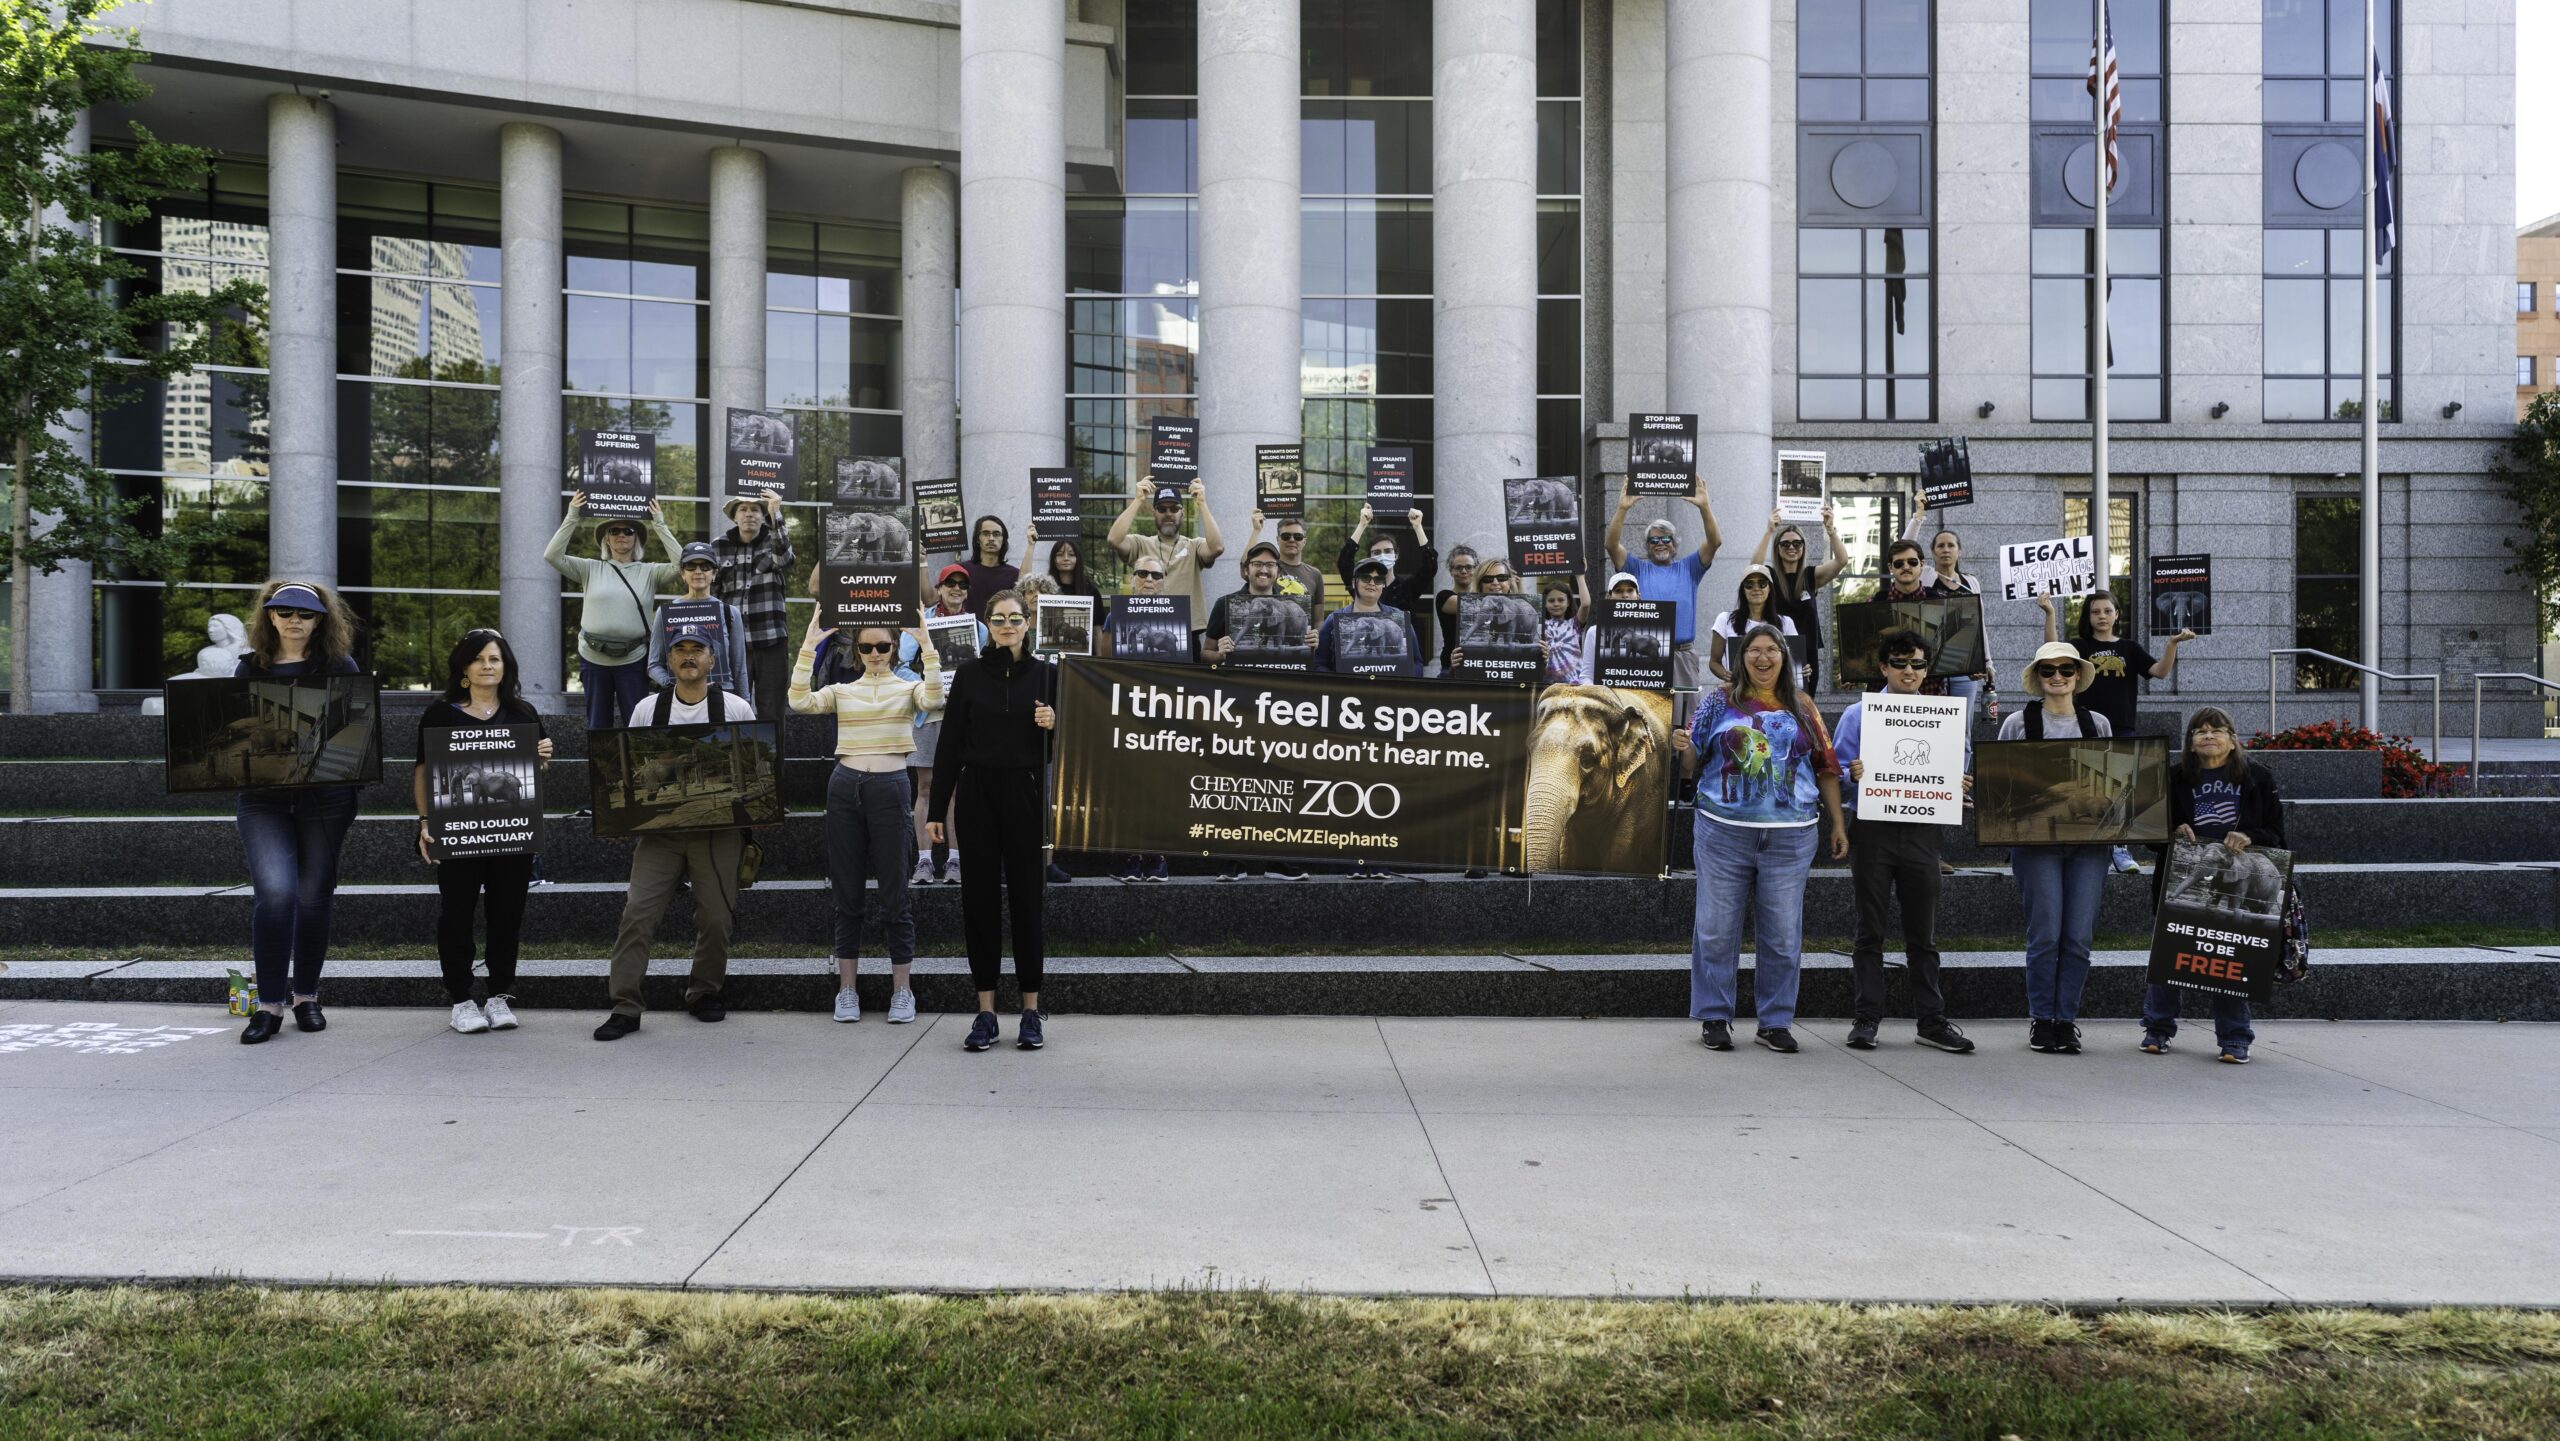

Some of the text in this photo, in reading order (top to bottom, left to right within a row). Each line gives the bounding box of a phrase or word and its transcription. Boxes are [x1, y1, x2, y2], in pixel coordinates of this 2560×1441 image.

[595, 441, 639, 449] SUFFERING
[741, 459, 782, 469] CAPTIVITY
[748, 470, 776, 478] HARMS
[738, 479, 785, 489] ELEPHANTS
[1941, 482, 1968, 490] WANTS
[614, 494, 646, 502] LOULOU
[600, 504, 649, 512] SANCTUARY
[2009, 538, 2088, 567] LEGAL
[1524, 552, 1569, 565] FREE.
[2010, 559, 2094, 584] RIGHTS FOR
[841, 576, 896, 584] CAPTIVITY
[2005, 573, 2095, 600] ELEPHANTS
[850, 590, 890, 598] HARMS
[838, 604, 902, 612] ELEPHANTS
[1485, 661, 1536, 669] DESERVES
[1501, 671, 1513, 679] BE
[1615, 680, 1666, 688] SANCTUARY
[1111, 683, 1500, 741] I think, feel & speak.
[1868, 704, 1882, 712] I'M
[1903, 706, 1959, 715] ELEPHANT
[1885, 719, 1941, 728] BIOLOGIST
[451, 729, 510, 739] STOP HER
[449, 741, 516, 751] SUFFERING
[1113, 728, 1490, 768] I suffer, but you don't hear me.
[1875, 773, 1944, 784] ELEPHANTS
[1190, 775, 1294, 796] CHEYENNE
[1299, 779, 1400, 819] ZOO
[1865, 788, 1952, 800] DON'T BELONG
[1189, 793, 1293, 813] MOUNTAIN
[1884, 805, 1935, 816] IN ZOOS
[445, 818, 529, 831] SEND LOULOU
[441, 832, 534, 846] TO SANCTUARY
[1189, 823, 1399, 849] #FreeTheCMZElephants
[2167, 923, 2269, 948] SHE DESERVES
[2195, 941, 2235, 956] TO BE
[2175, 952, 2248, 982] FREE.
